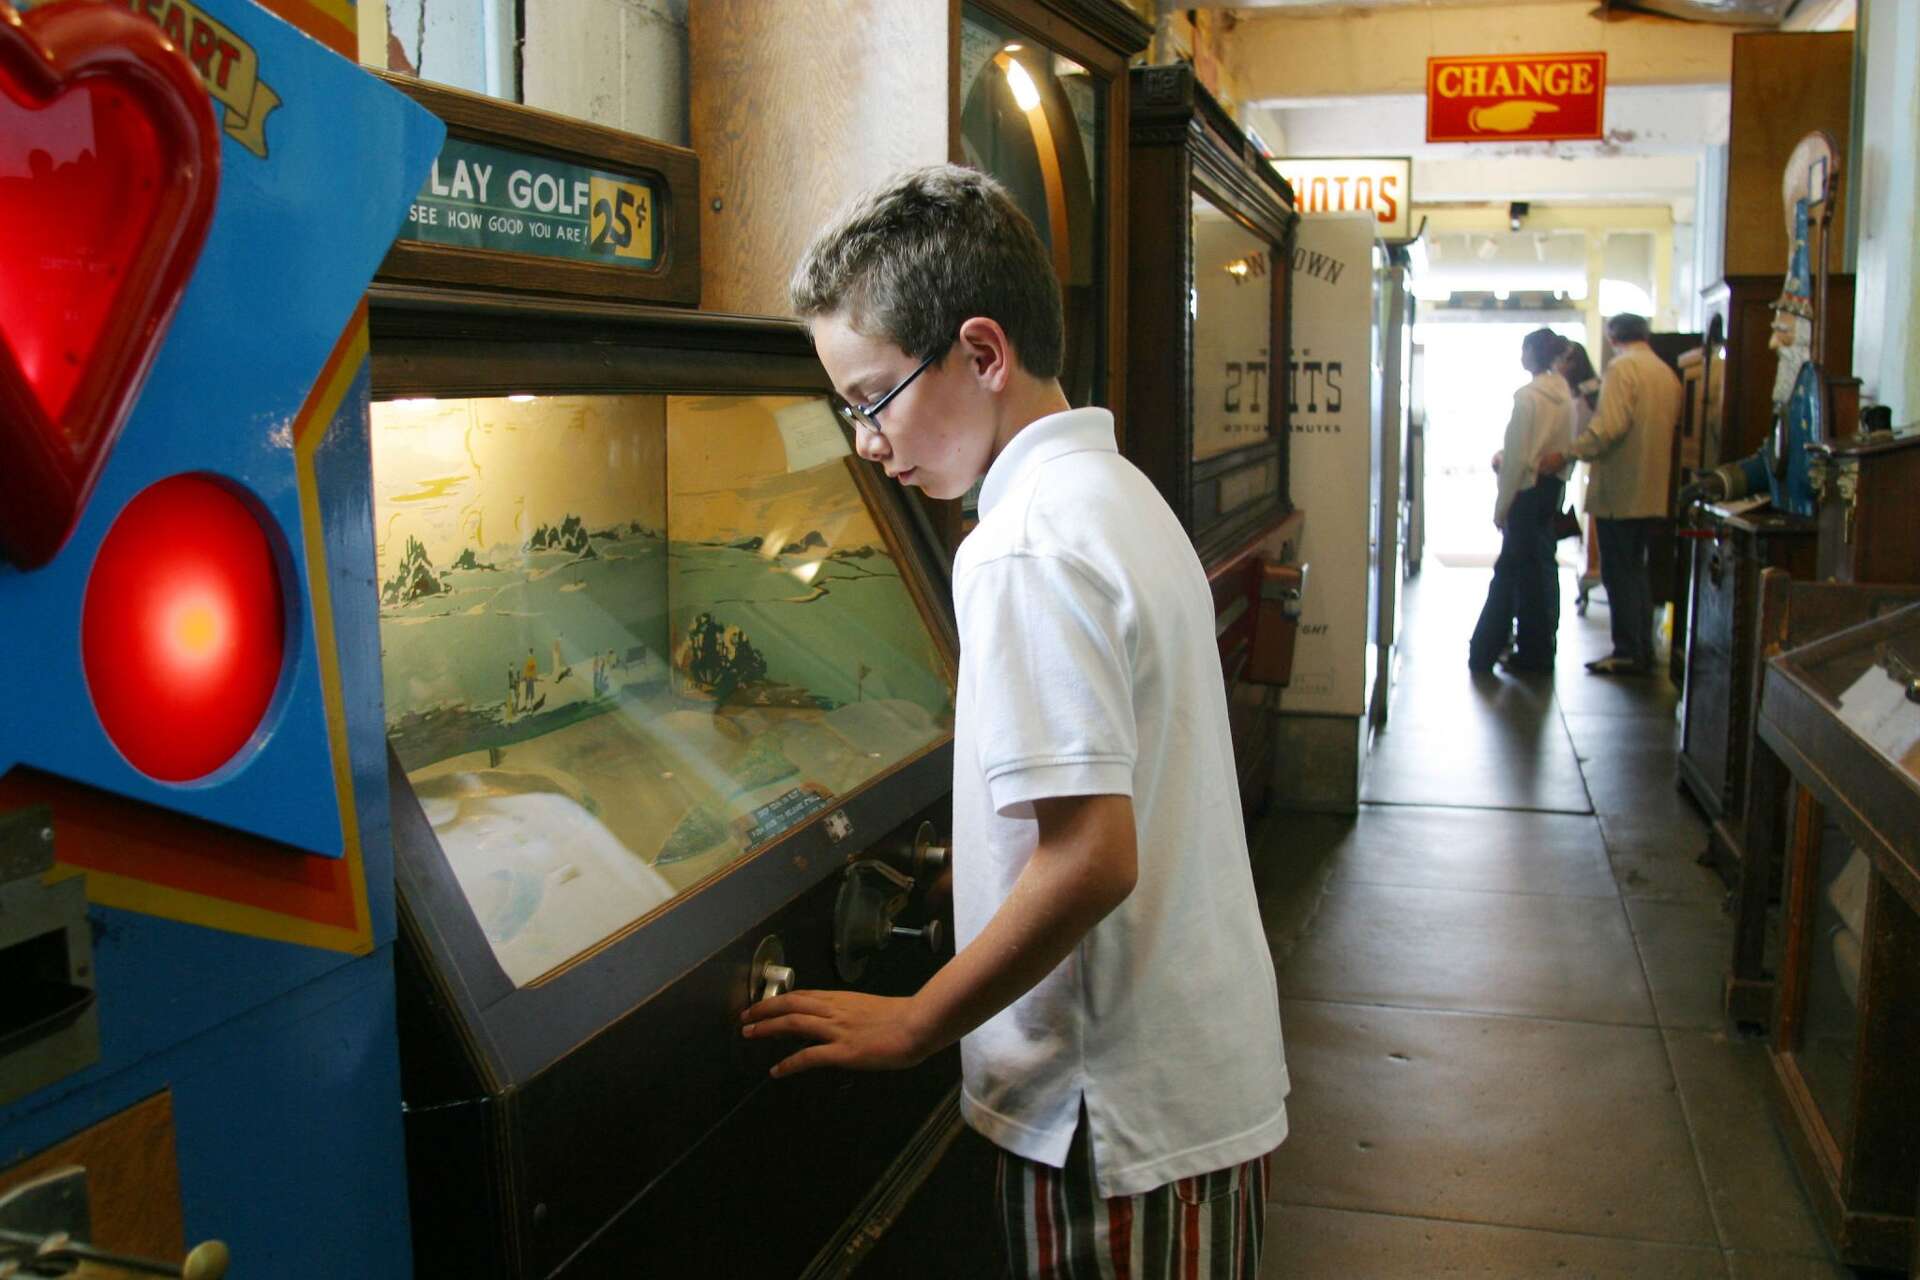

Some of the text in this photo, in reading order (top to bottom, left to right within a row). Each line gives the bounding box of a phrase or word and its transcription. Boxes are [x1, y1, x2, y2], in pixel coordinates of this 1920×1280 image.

[1436, 63, 1594, 98] CHANGE
[431, 157, 589, 216] LAY GOLF
[1286, 175, 1397, 223] HOTOS
[409, 203, 438, 226] SEE
[448, 210, 483, 230] HOW
[488, 215, 524, 234] GOOD
[529, 221, 551, 239] YOU
[590, 188, 647, 252] 25¢
[1288, 361, 1342, 413] ITS
